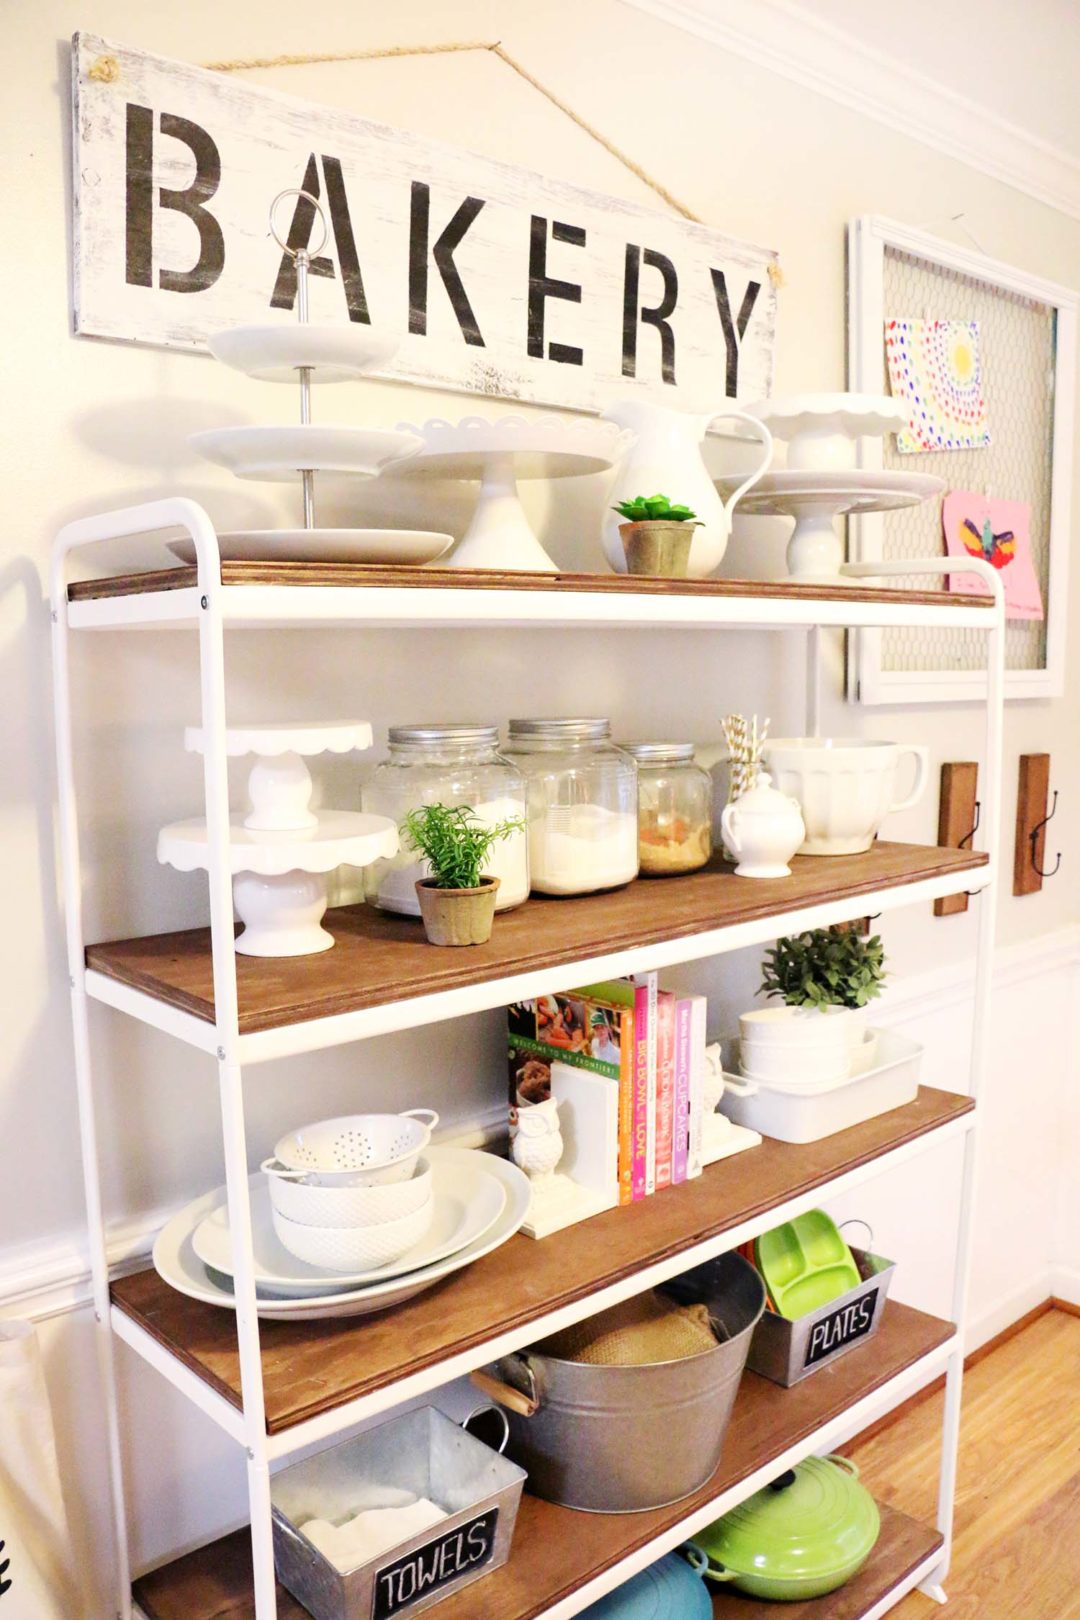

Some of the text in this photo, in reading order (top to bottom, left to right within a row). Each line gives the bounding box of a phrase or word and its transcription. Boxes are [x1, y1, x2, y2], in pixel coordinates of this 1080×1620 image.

[125, 102, 762, 398] BAKERY
[513, 1039, 547, 1055] WELCOME
[549, 1049, 560, 1058] TO
[636, 1039, 648, 1065] BIG
[636, 1067, 647, 1113] BOWL
[676, 1073, 688, 1153] CUPCAKES
[635, 1121, 647, 1161] LOVE
[810, 1296, 872, 1359] PLATES
[380, 1519, 487, 1610] TOWELS
